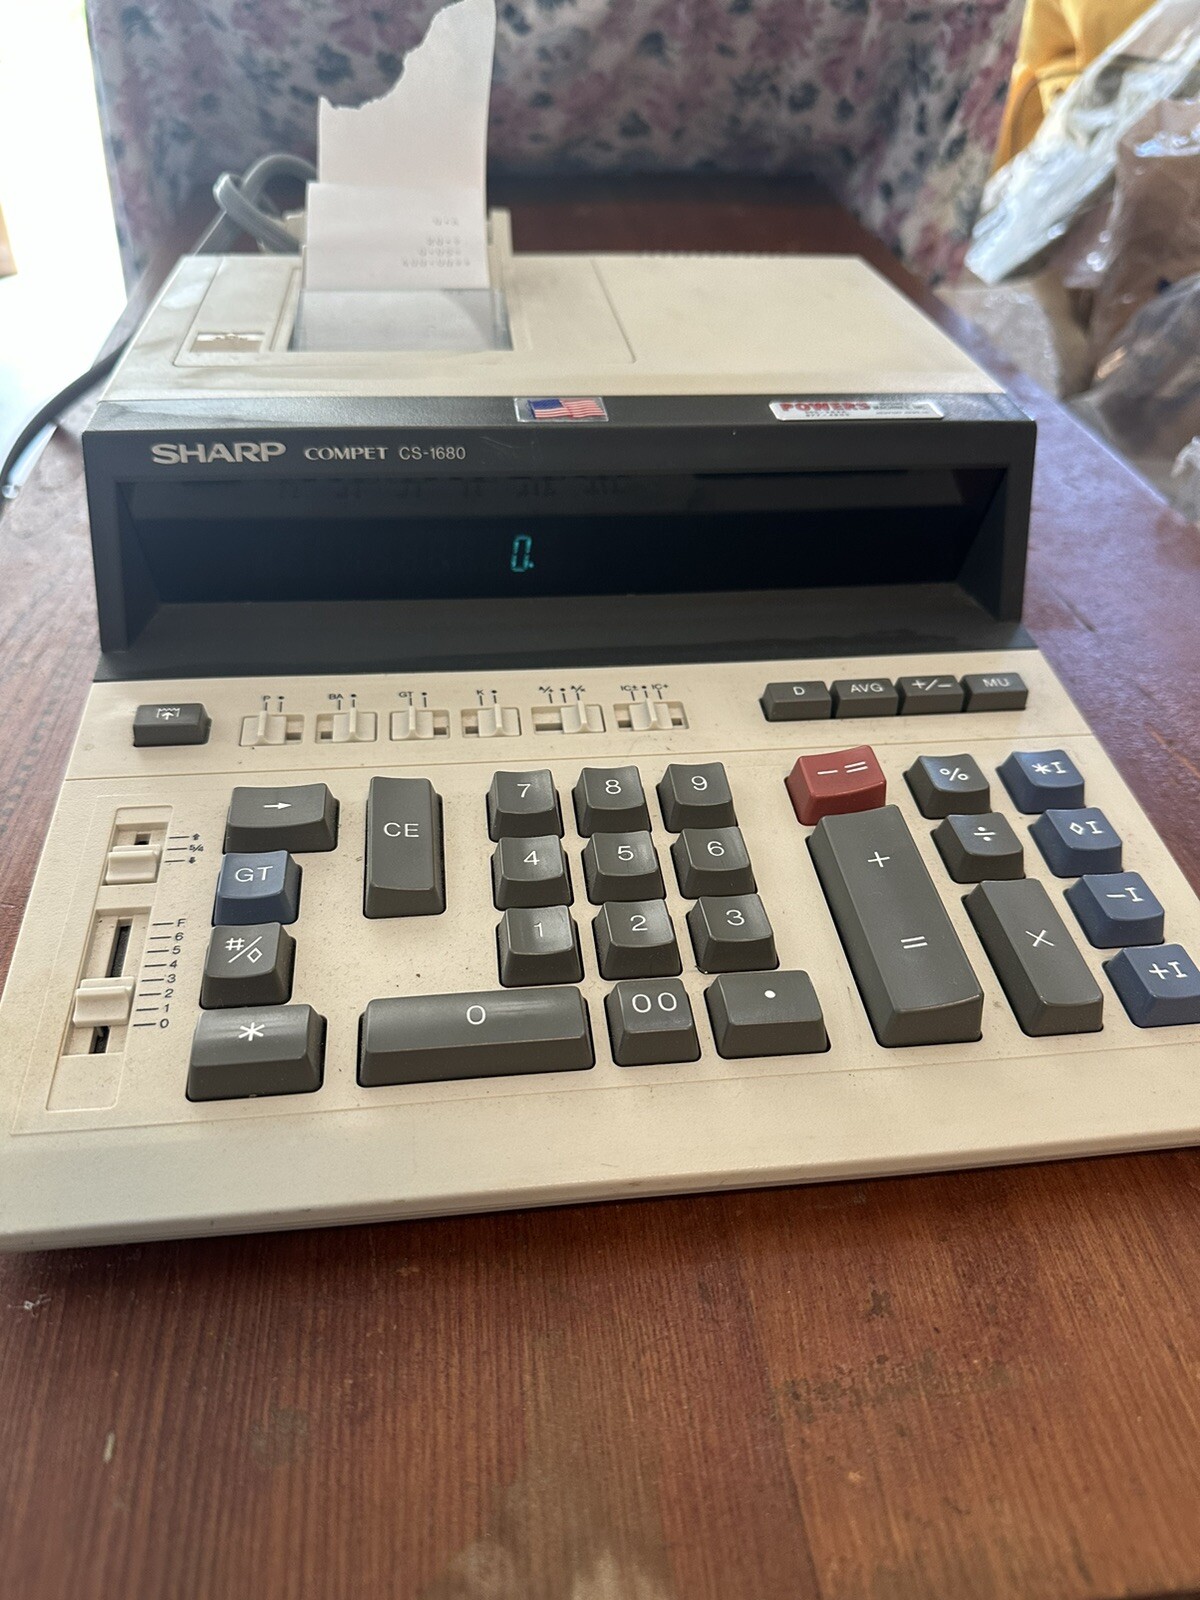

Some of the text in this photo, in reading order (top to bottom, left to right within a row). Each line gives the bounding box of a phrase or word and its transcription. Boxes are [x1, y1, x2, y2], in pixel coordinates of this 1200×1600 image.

[151, 442, 286, 465] SHARP
[304, 446, 467, 460] COMPET CS-1680
[850, 683, 884, 694] AVG
[982, 677, 1011, 688] MU
[398, 691, 414, 699] GT
[793, 686, 806, 697] D
[516, 783, 532, 798] 7
[604, 778, 622, 795] 8
[690, 775, 708, 792] 9
[383, 822, 420, 839] CE
[616, 845, 635, 862] 5
[707, 840, 726, 857] 6
[522, 849, 541, 866] 4
[234, 865, 274, 882] GT
[177, 919, 186, 927] F
[629, 914, 649, 931] 2
[726, 909, 746, 926] 3
[174, 932, 184, 941] 6
[532, 921, 544, 938] 1
[172, 946, 181, 955] 5
[169, 960, 178, 969] 4
[167, 974, 176, 984] 3
[164, 989, 174, 998] 2
[163, 1004, 170, 1012] 1
[630, 991, 678, 1013] 00
[465, 1004, 487, 1025] 0
